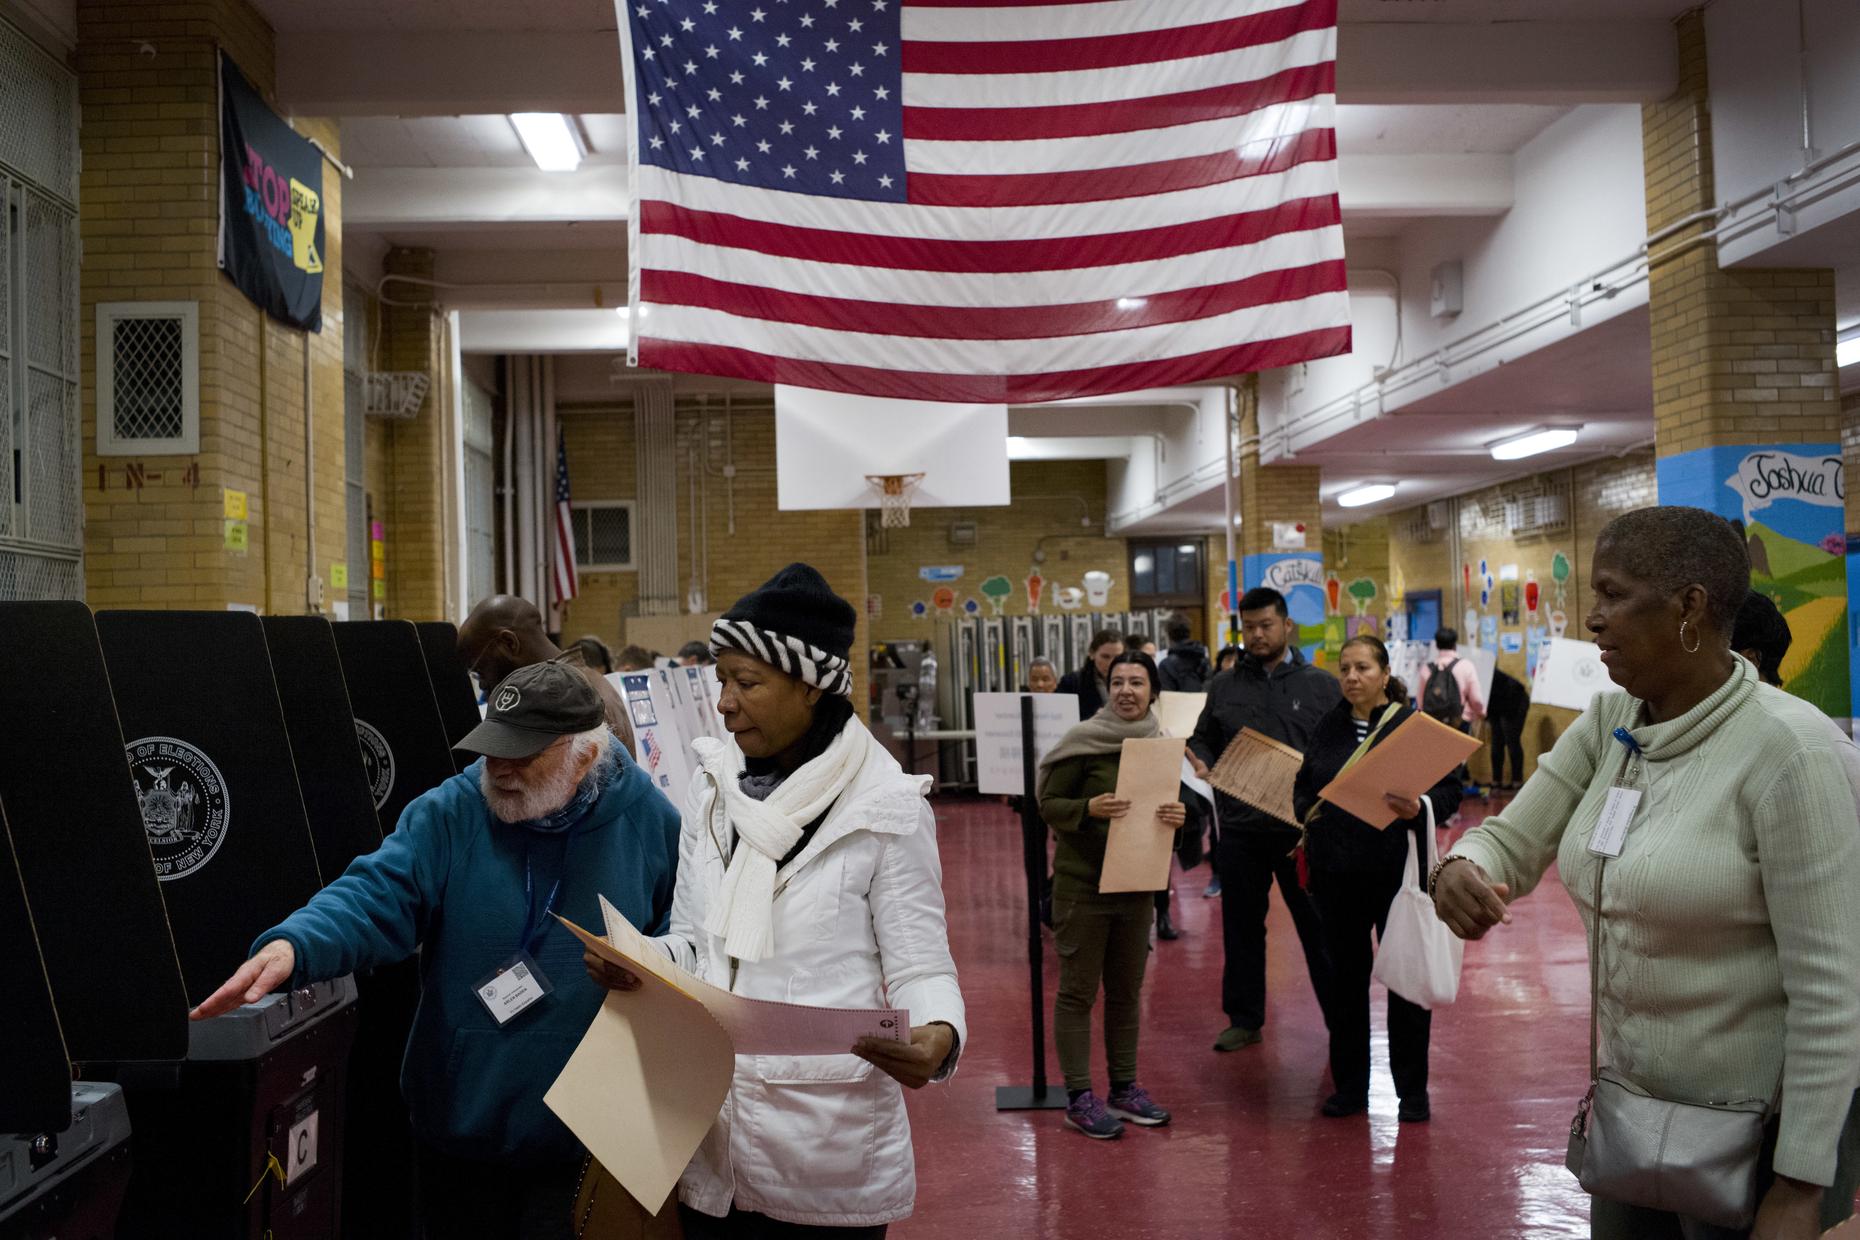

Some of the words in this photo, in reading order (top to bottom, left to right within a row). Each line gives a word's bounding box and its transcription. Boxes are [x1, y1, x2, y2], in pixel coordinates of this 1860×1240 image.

[1748, 453, 1826, 498] Joshua
[136, 744, 155, 758] OF
[159, 743, 220, 795] ELECTIONS
[155, 862, 172, 874] OF
[175, 846, 205, 871] NEW
[201, 808, 224, 847] YORK
[297, 1129, 308, 1165] C
